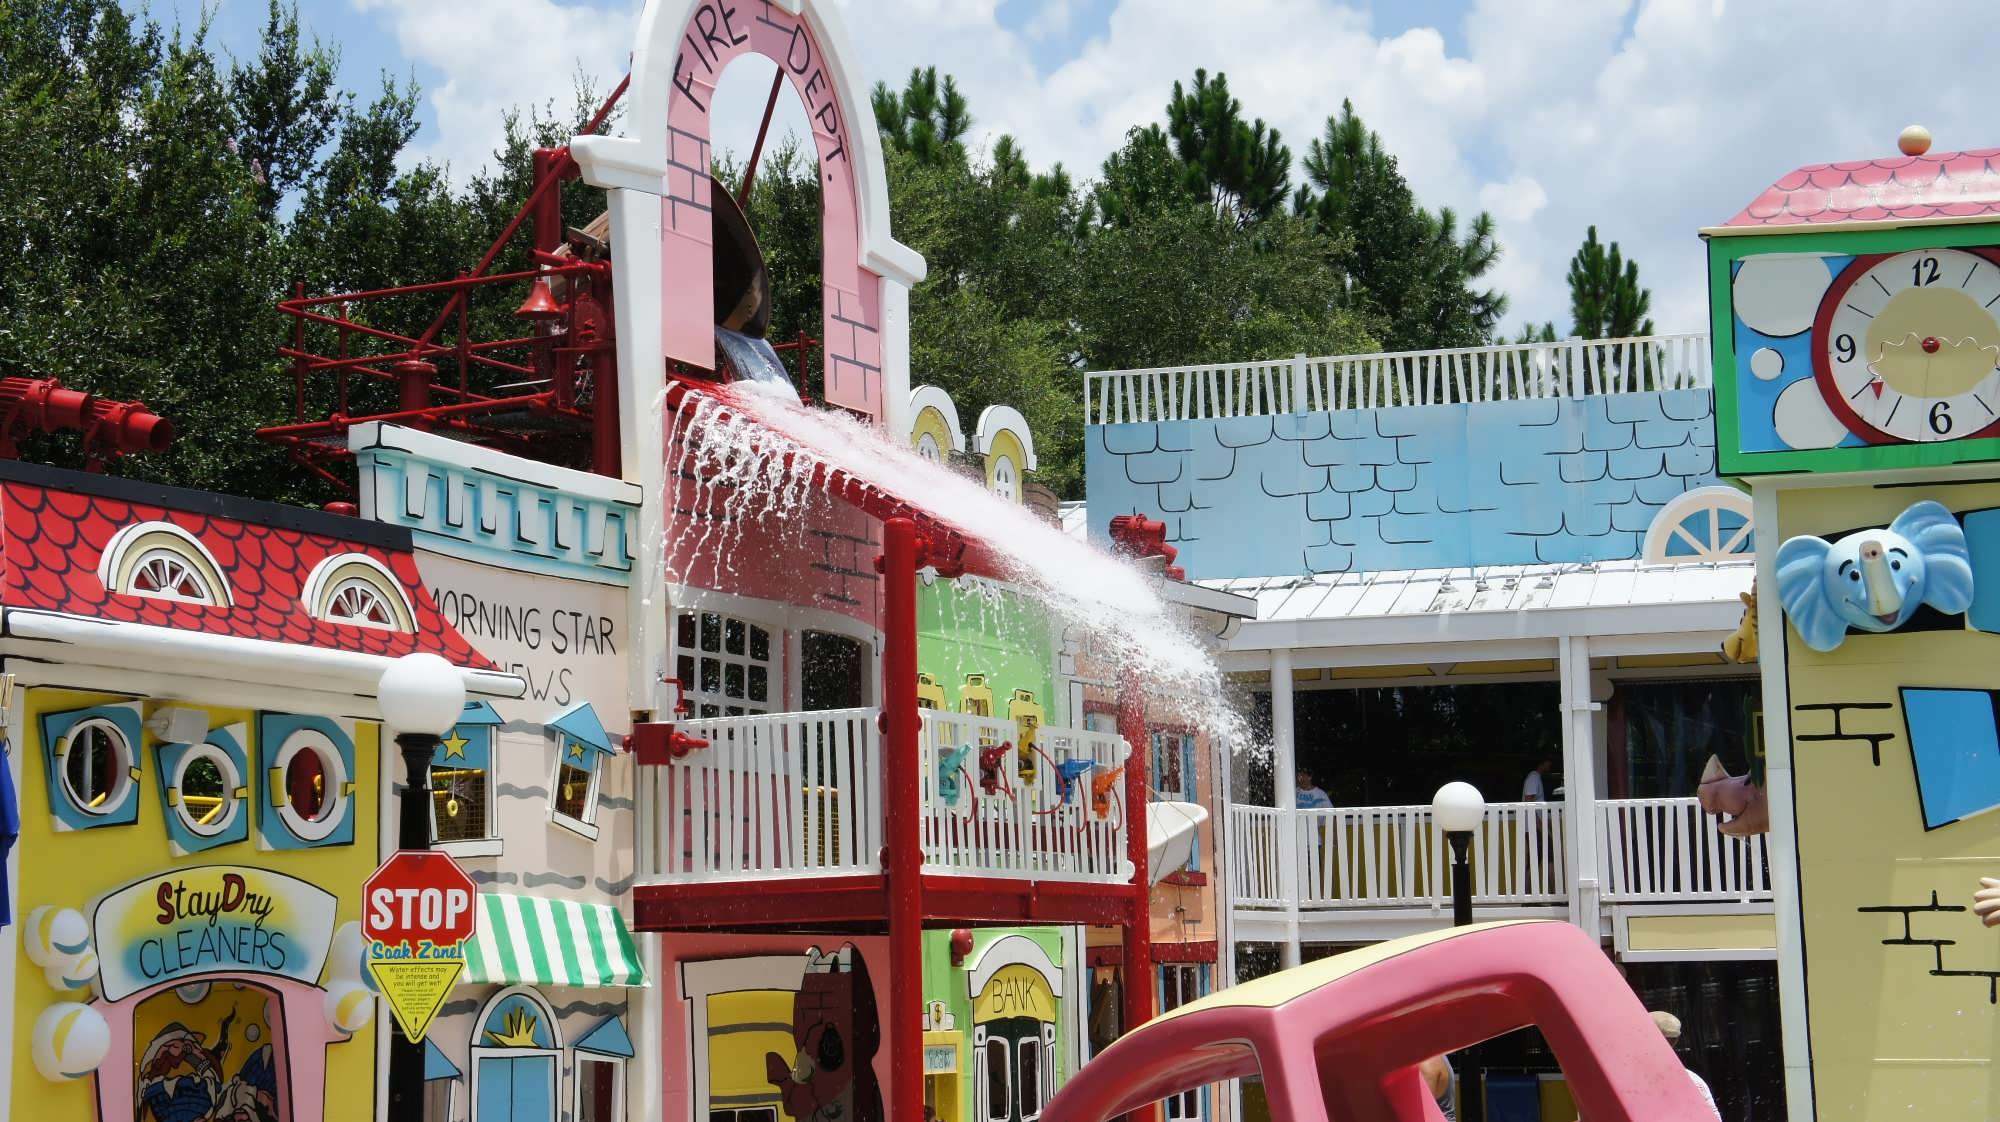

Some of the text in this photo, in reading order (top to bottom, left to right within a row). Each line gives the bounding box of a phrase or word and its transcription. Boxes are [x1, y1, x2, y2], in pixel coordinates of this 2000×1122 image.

[672, 0, 847, 183] FIRE DEPT.
[1912, 257, 1941, 287] 12
[1836, 334, 1856, 363] 9
[1929, 401, 1952, 434] 6
[551, 609, 616, 655] STAR
[370, 887, 469, 930] STOP
[139, 926, 286, 979] CLEANERS
[371, 939, 464, 959] Soak Zone!
[992, 976, 1037, 1013] BANK
